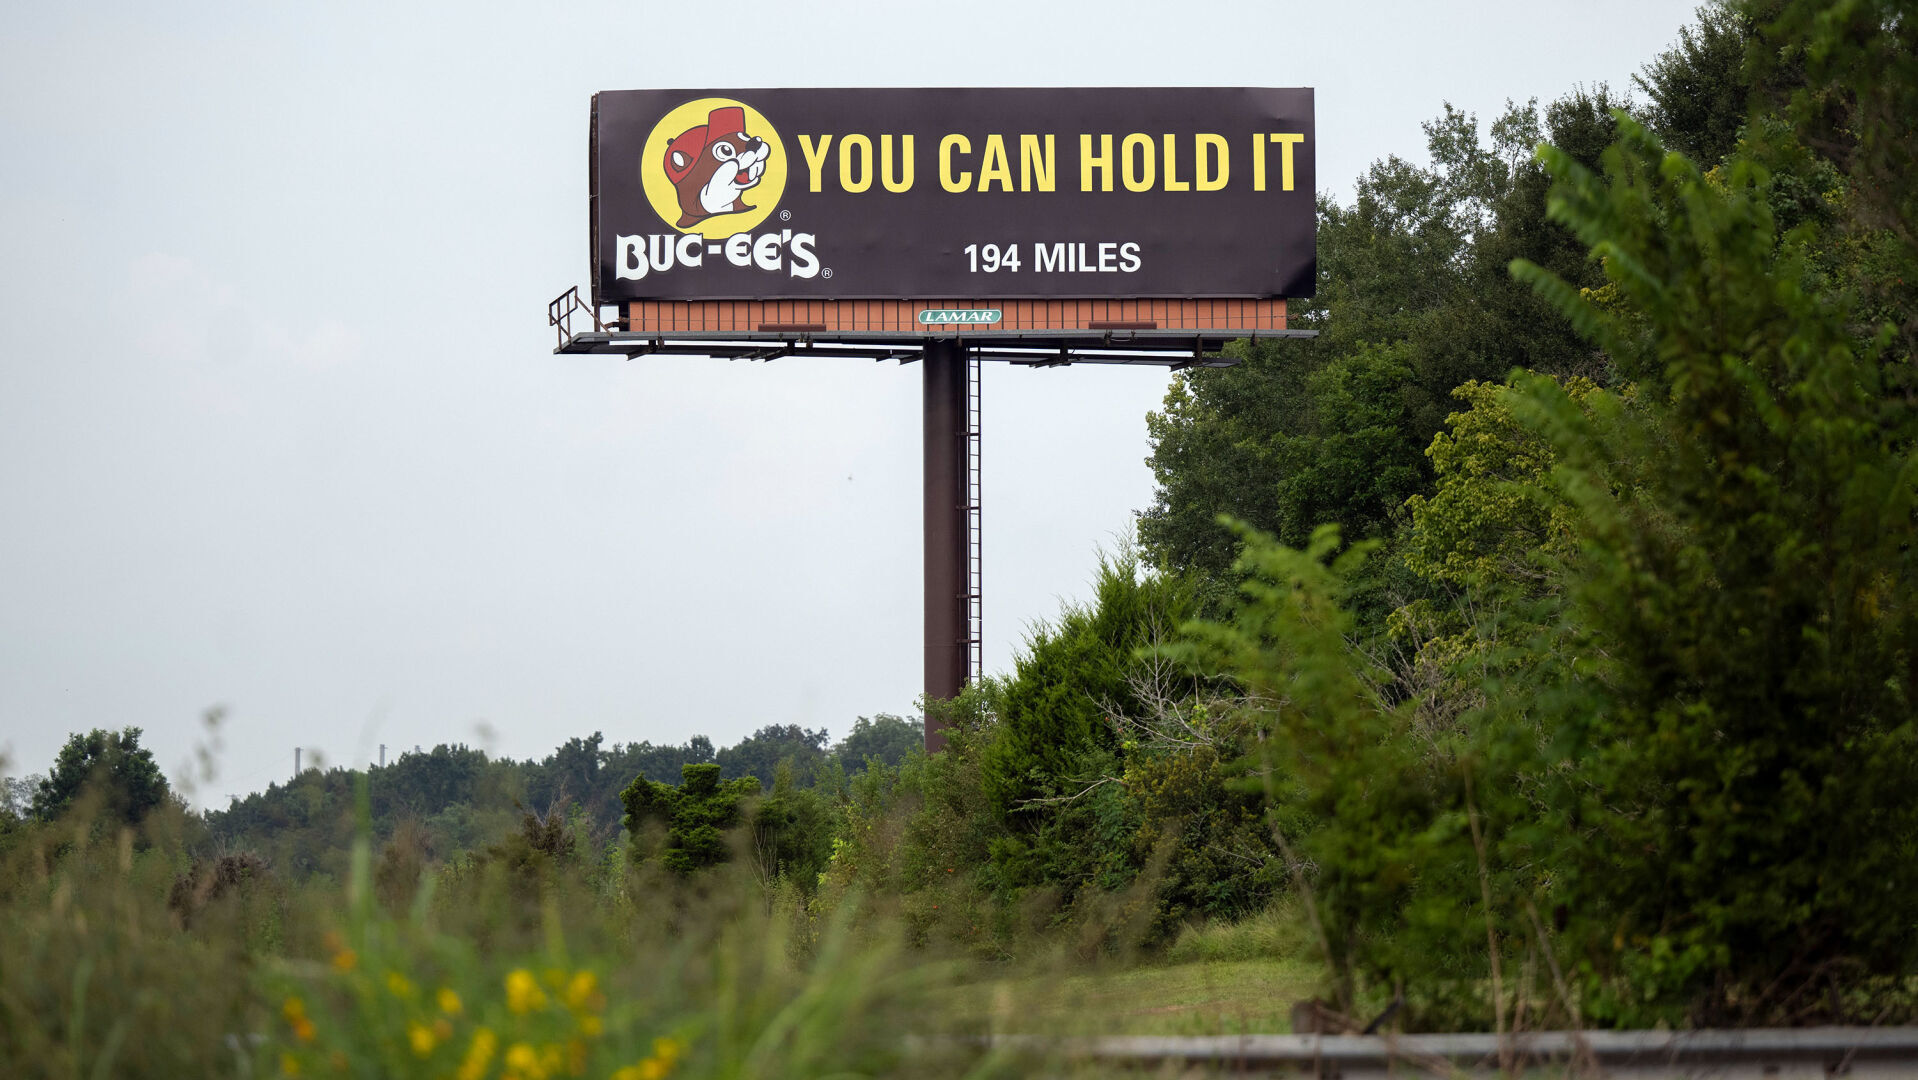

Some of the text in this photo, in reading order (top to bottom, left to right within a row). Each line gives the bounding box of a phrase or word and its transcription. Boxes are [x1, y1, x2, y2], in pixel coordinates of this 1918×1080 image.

[797, 132, 1305, 194] YOU CAN HOLD IT
[615, 228, 820, 281] BUC-EE'S
[964, 242, 1142, 273] 194 MILES
[925, 311, 993, 322] LAMAR
